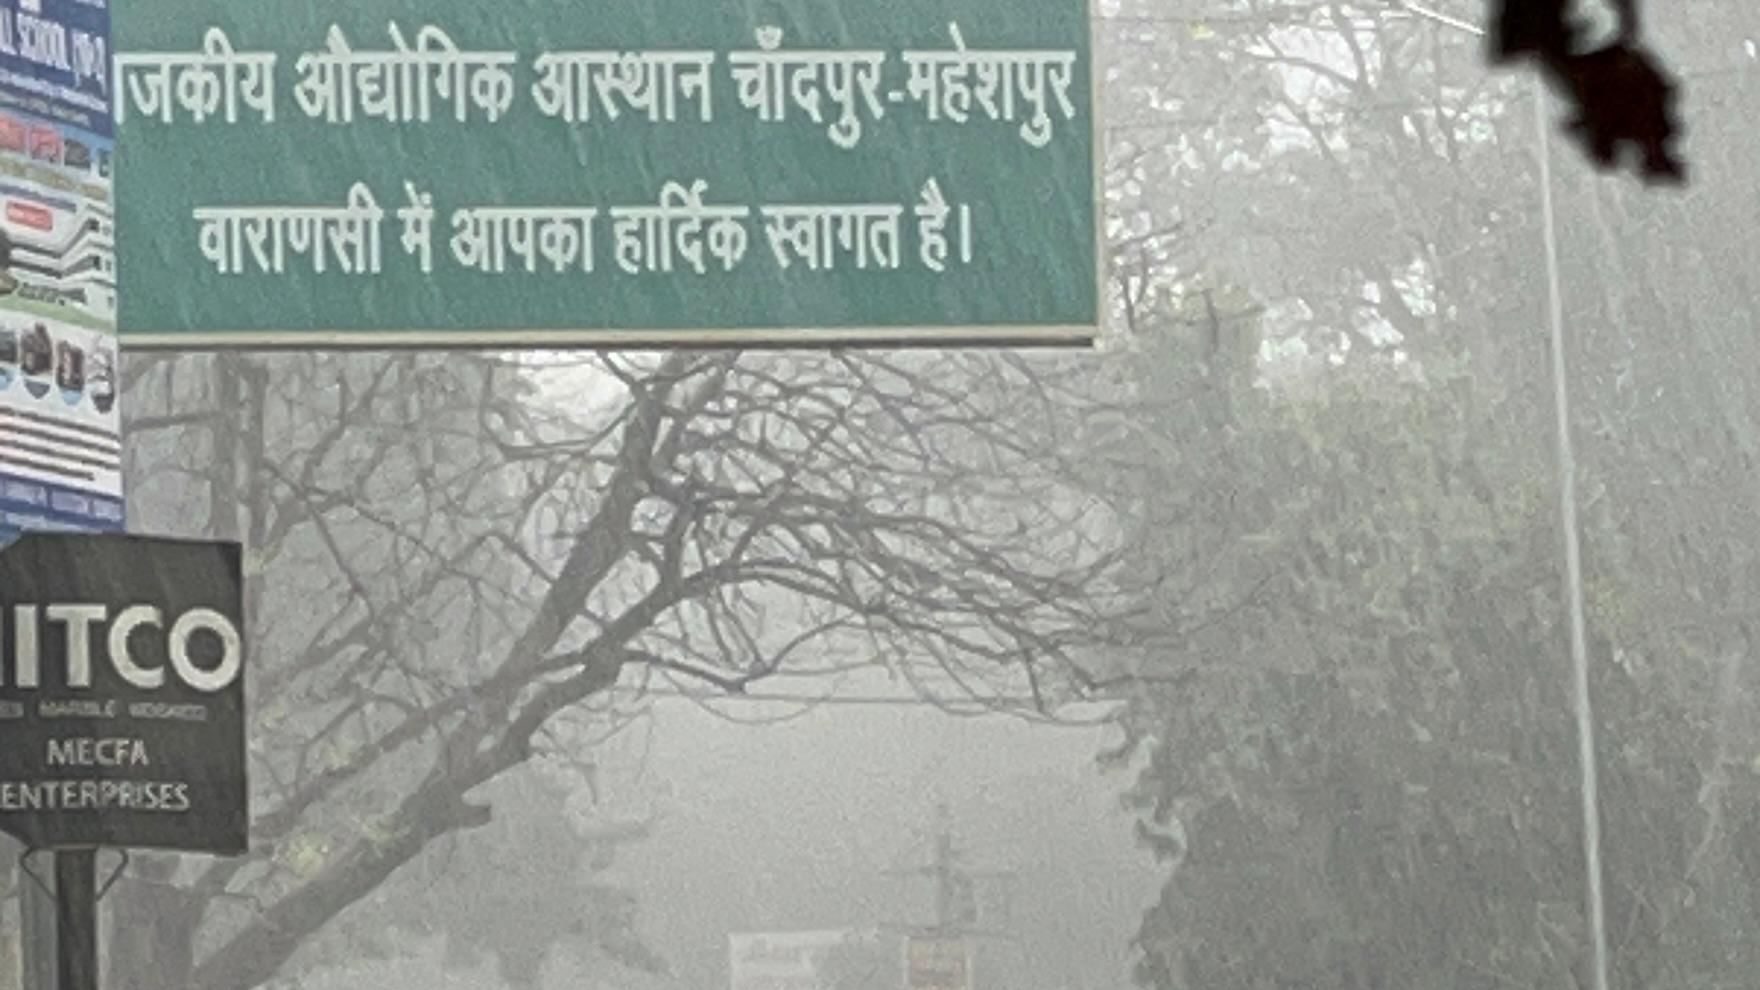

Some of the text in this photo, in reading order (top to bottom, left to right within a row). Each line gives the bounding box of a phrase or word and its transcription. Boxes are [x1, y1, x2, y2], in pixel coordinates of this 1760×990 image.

[114, 27, 278, 125] ाजकीय
[294, 20, 518, 125] औद्योगिक
[531, 49, 715, 123] आस्थान
[193, 181, 384, 274] वाराणसी
[397, 180, 433, 272] में
[450, 206, 598, 273] आपका
[610, 179, 749, 273] हार्दिक
[761, 204, 903, 270] स्वागत
[0, 604, 241, 691] ITCO
[1, 780, 190, 811] ENTERPRISES
[47, 737, 149, 767] MECFA
